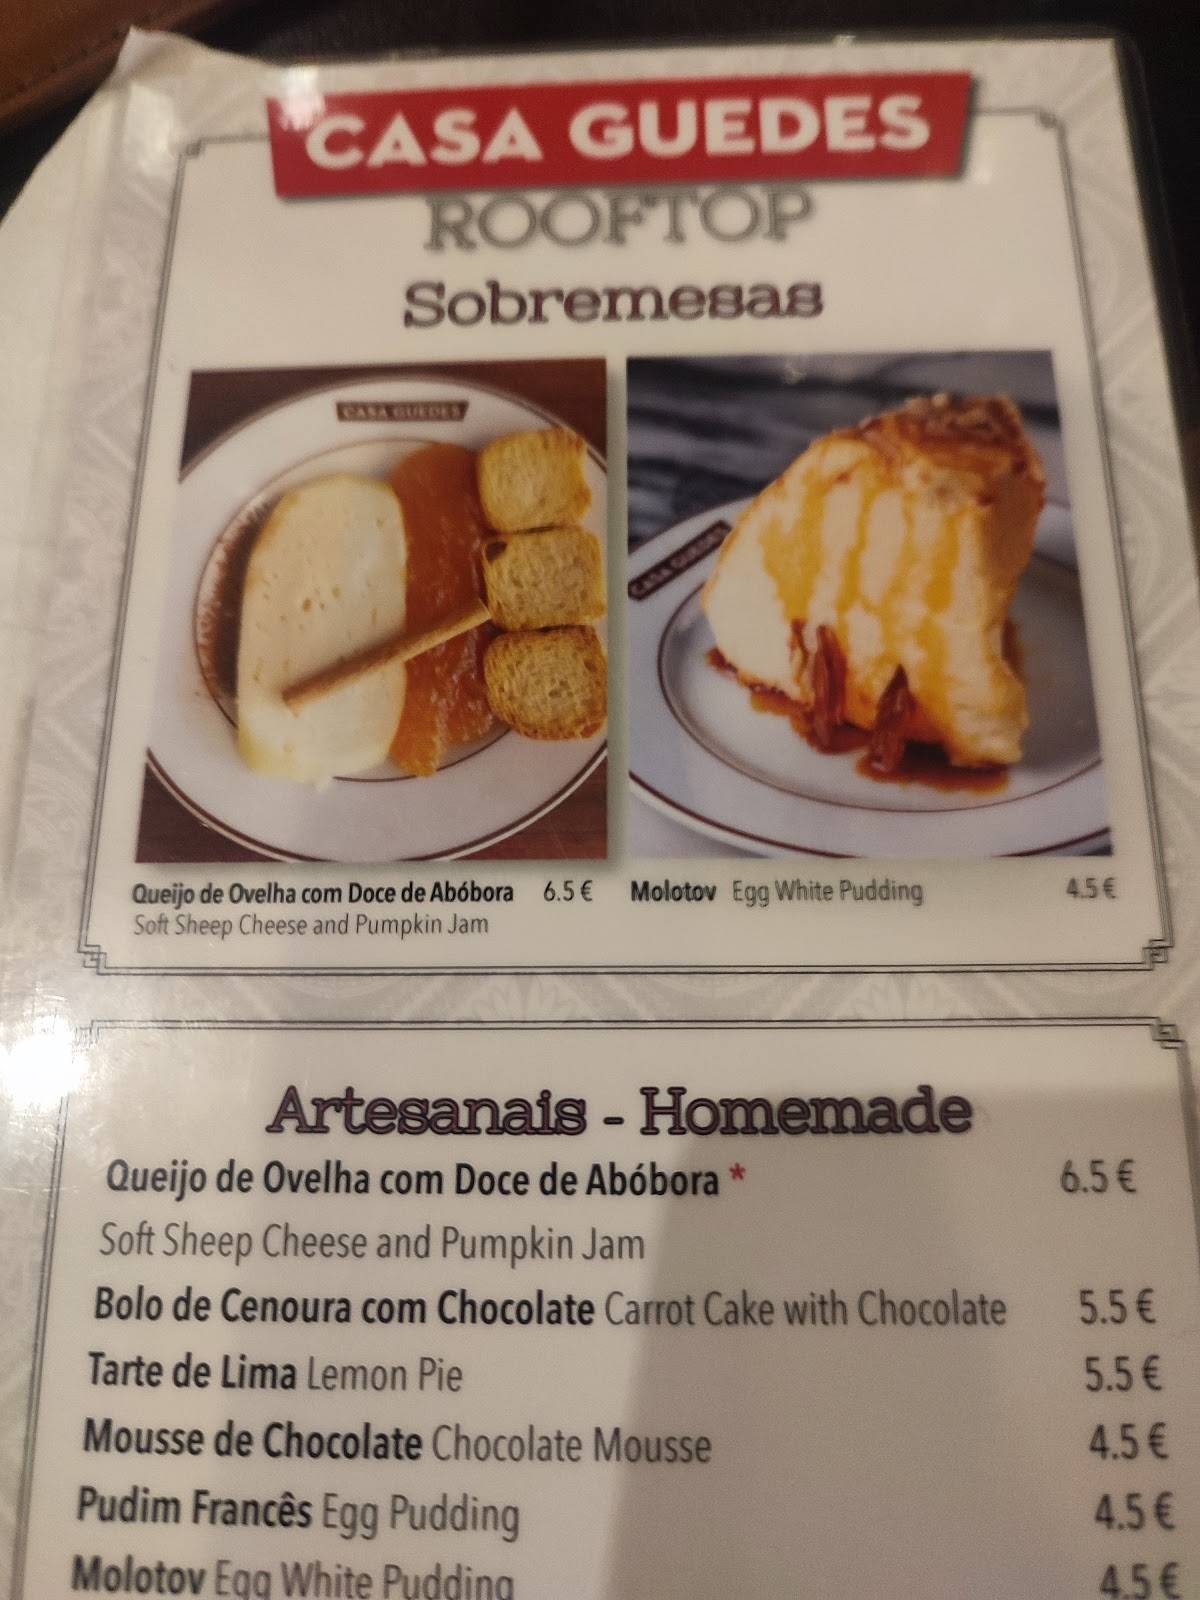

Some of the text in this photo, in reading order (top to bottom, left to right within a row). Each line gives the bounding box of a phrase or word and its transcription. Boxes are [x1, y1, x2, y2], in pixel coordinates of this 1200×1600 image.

[306, 95, 930, 169] CASA GUEDES
[424, 187, 815, 250] ROOFTOP
[404, 281, 824, 327] Sobremesas
[132, 882, 195, 909] Queijo
[200, 884, 224, 903] de
[229, 882, 296, 903] Ovelha
[302, 888, 342, 903] com
[348, 882, 396, 903] Doce
[401, 881, 425, 903] de
[430, 881, 514, 903] Abóbora
[631, 881, 717, 902] Molotov
[733, 881, 769, 907] Egg
[775, 880, 834, 902] White
[840, 880, 923, 906] Pudding
[134, 912, 488, 940] Soft Sheep Cheese and Pumpkin Jam
[266, 1086, 587, 1136] Artesanais
[640, 1085, 973, 1135] Homemade
[106, 1158, 206, 1201] Queijo
[217, 1159, 253, 1193] de
[264, 1160, 370, 1194] Ovelha
[380, 1168, 443, 1195] com
[455, 1162, 529, 1196] Doce
[540, 1162, 577, 1196] de
[586, 1162, 719, 1196] Abóbora
[100, 1221, 645, 1268] Soft Sheep Cheese and Pumpkin Jam
[95, 1285, 163, 1320] Bolo
[173, 1286, 211, 1322] de
[222, 1287, 350, 1323] Cenoura
[362, 1297, 426, 1324] com
[438, 1289, 595, 1325] Chocolate
[605, 1290, 694, 1326] Carrot
[704, 1290, 774, 1326] Cake
[786, 1291, 847, 1325] with
[858, 1290, 1006, 1325] Chocolate
[89, 1351, 163, 1387] Tarte
[173, 1352, 211, 1388] de
[222, 1354, 297, 1389] Lima
[308, 1357, 407, 1392] Lemon
[419, 1357, 463, 1392] Pie
[83, 1418, 204, 1455] Mousse
[215, 1419, 253, 1457] de
[264, 1421, 422, 1461] Chocolate
[433, 1424, 583, 1462] Chocolate
[594, 1427, 712, 1463] Mousse
[77, 1486, 180, 1524] Pudim
[193, 1490, 312, 1528] Francês
[323, 1493, 378, 1539] Egg
[390, 1493, 519, 1542] Pudding
[71, 1555, 206, 1595] Molotov
[281, 1561, 373, 1600] White
[383, 1564, 514, 1600] Pudding
